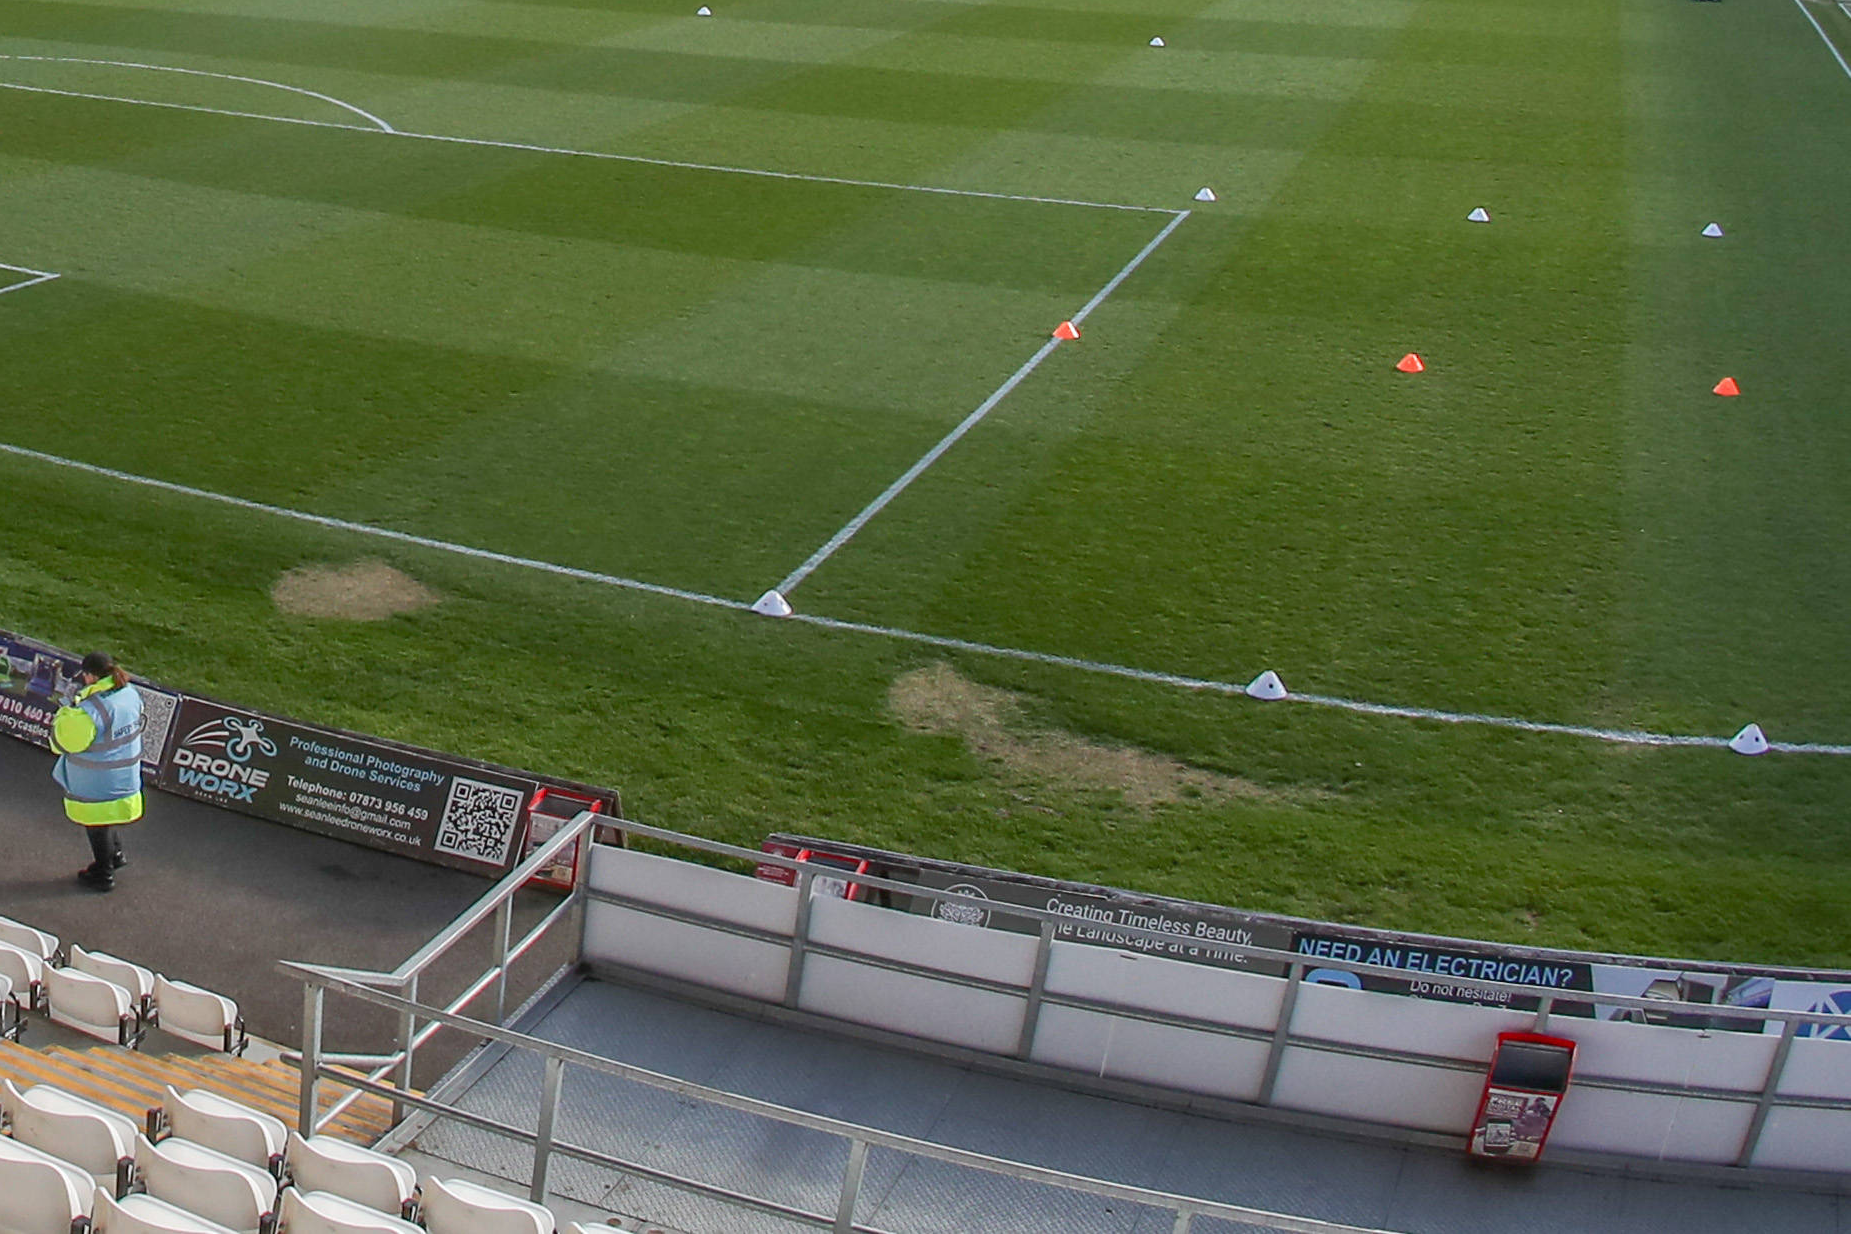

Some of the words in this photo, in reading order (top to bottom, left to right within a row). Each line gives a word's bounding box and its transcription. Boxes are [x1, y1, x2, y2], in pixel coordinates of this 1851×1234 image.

[22, 702, 45, 721] 460
[172, 747, 270, 789] DRONE
[289, 736, 365, 765] Professional
[366, 755, 446, 787] Photography
[304, 754, 327, 770] and
[330, 760, 366, 780] Drone
[368, 770, 422, 793] Services
[178, 767, 258, 804] WORX
[287, 774, 348, 802] Telephone:
[349, 791, 382, 810] 07873
[384, 800, 406, 816] 956
[406, 806, 429, 822] 459
[279, 802, 422, 847] www.seanleedroneworx.co.uk
[295, 792, 411, 831] seanleeinfo@gmail.com
[1046, 898, 1114, 926] Creating
[1118, 908, 1192, 936] Timeless
[1195, 922, 1253, 948] Beauty,
[1299, 937, 1363, 964] NEED
[1365, 947, 1401, 969] AN
[1405, 951, 1573, 989] ELECTRICIAN?
[1409, 979, 1429, 994] Do
[1431, 982, 1454, 996] not
